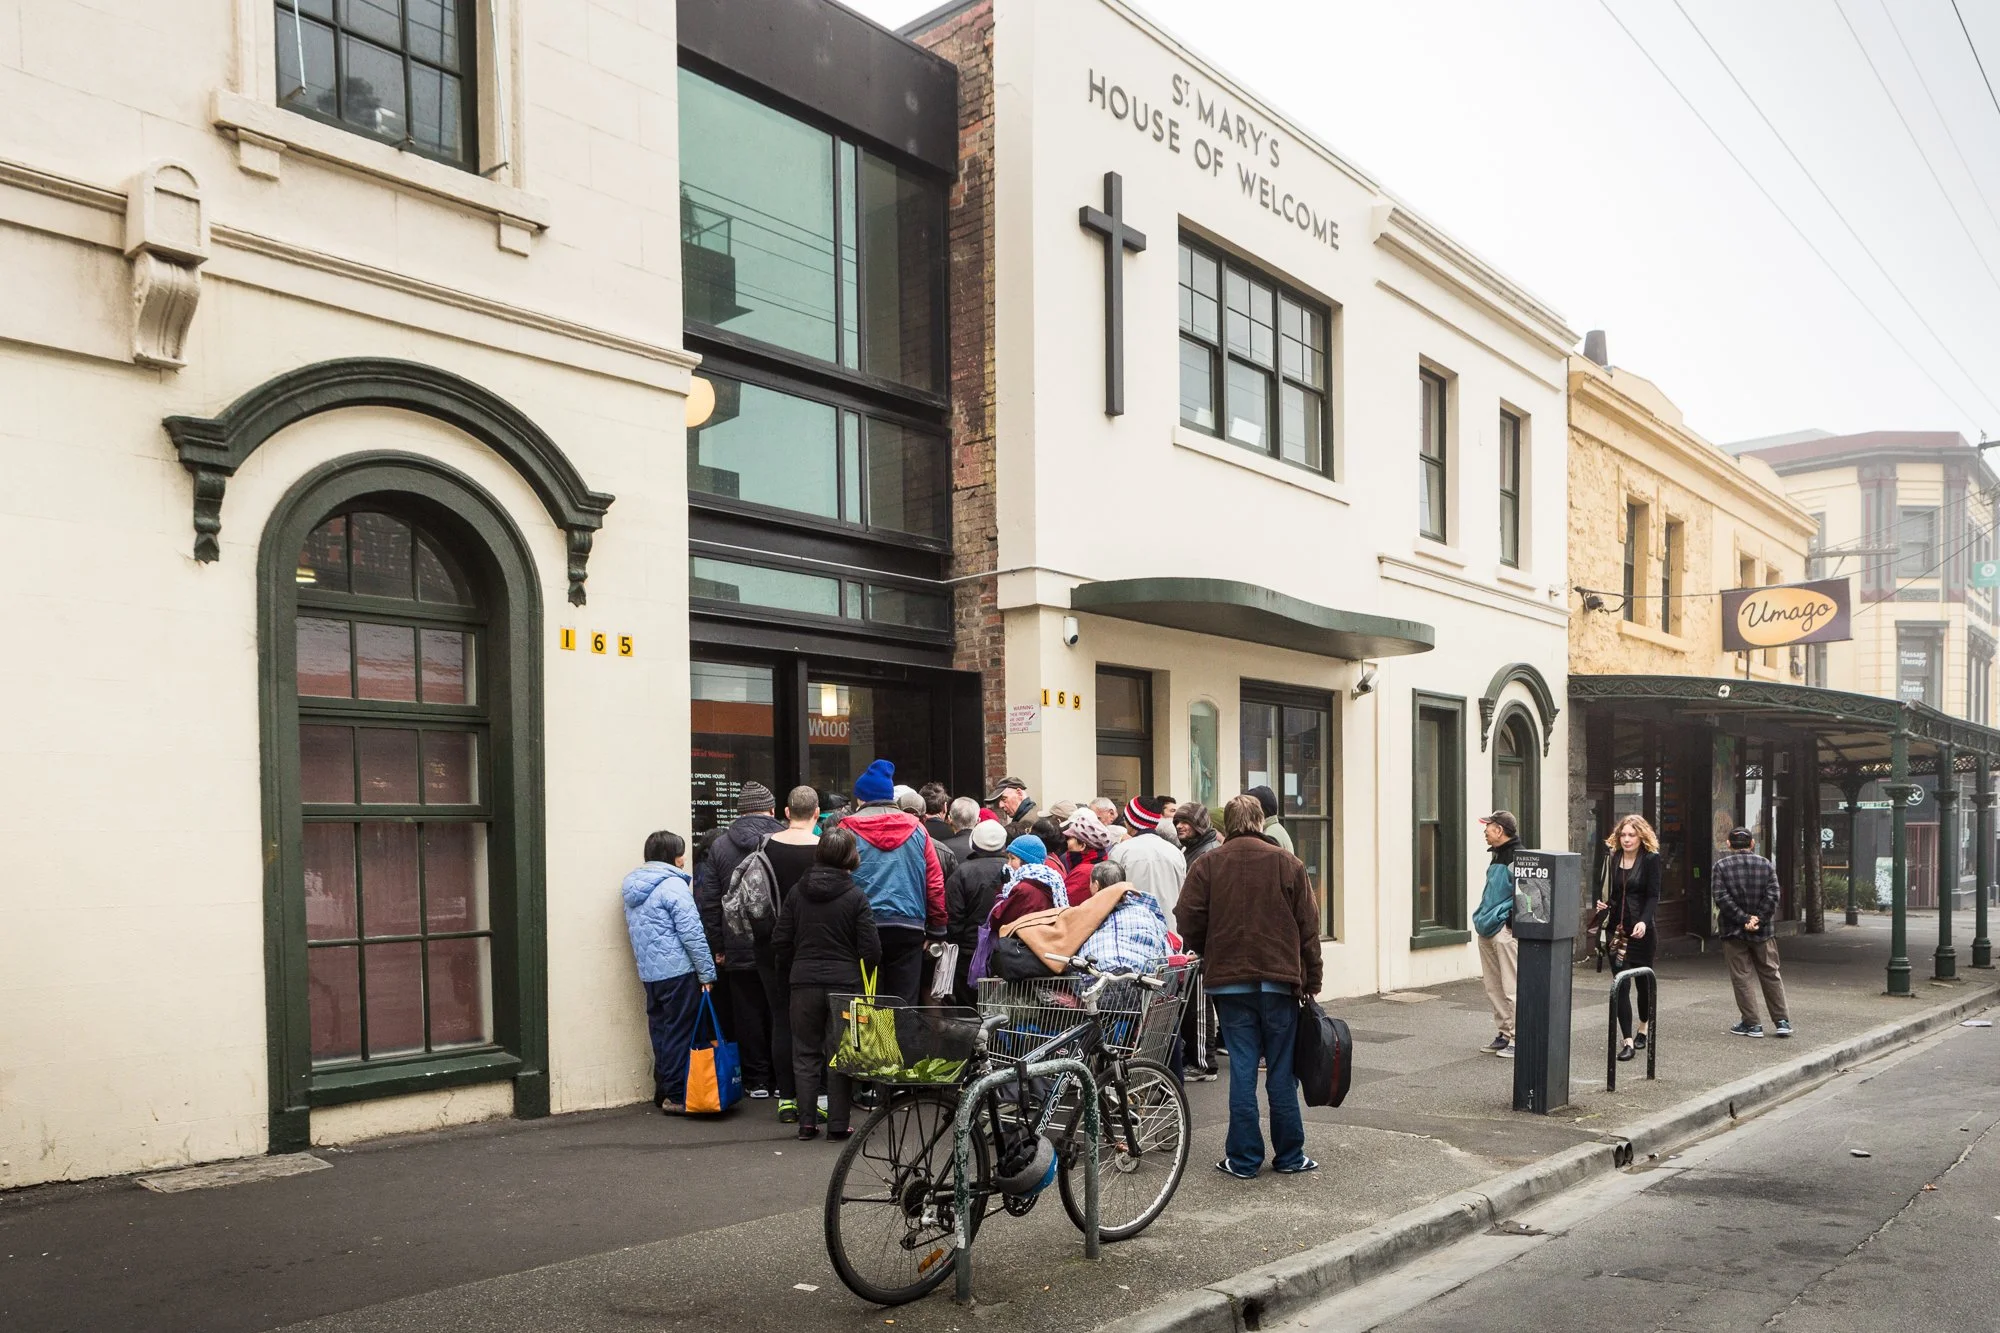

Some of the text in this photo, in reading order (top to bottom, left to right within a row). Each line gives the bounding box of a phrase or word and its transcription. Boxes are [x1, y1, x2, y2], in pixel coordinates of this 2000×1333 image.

[1197, 88, 1280, 168] MARY'S
[1089, 68, 1340, 250] HOUSE OF WELCOME
[1741, 601, 1832, 632] Umago
[1901, 651, 1926, 659] Massage
[1901, 658, 1926, 667] Therapy
[1514, 866, 1549, 878] BKT-09
